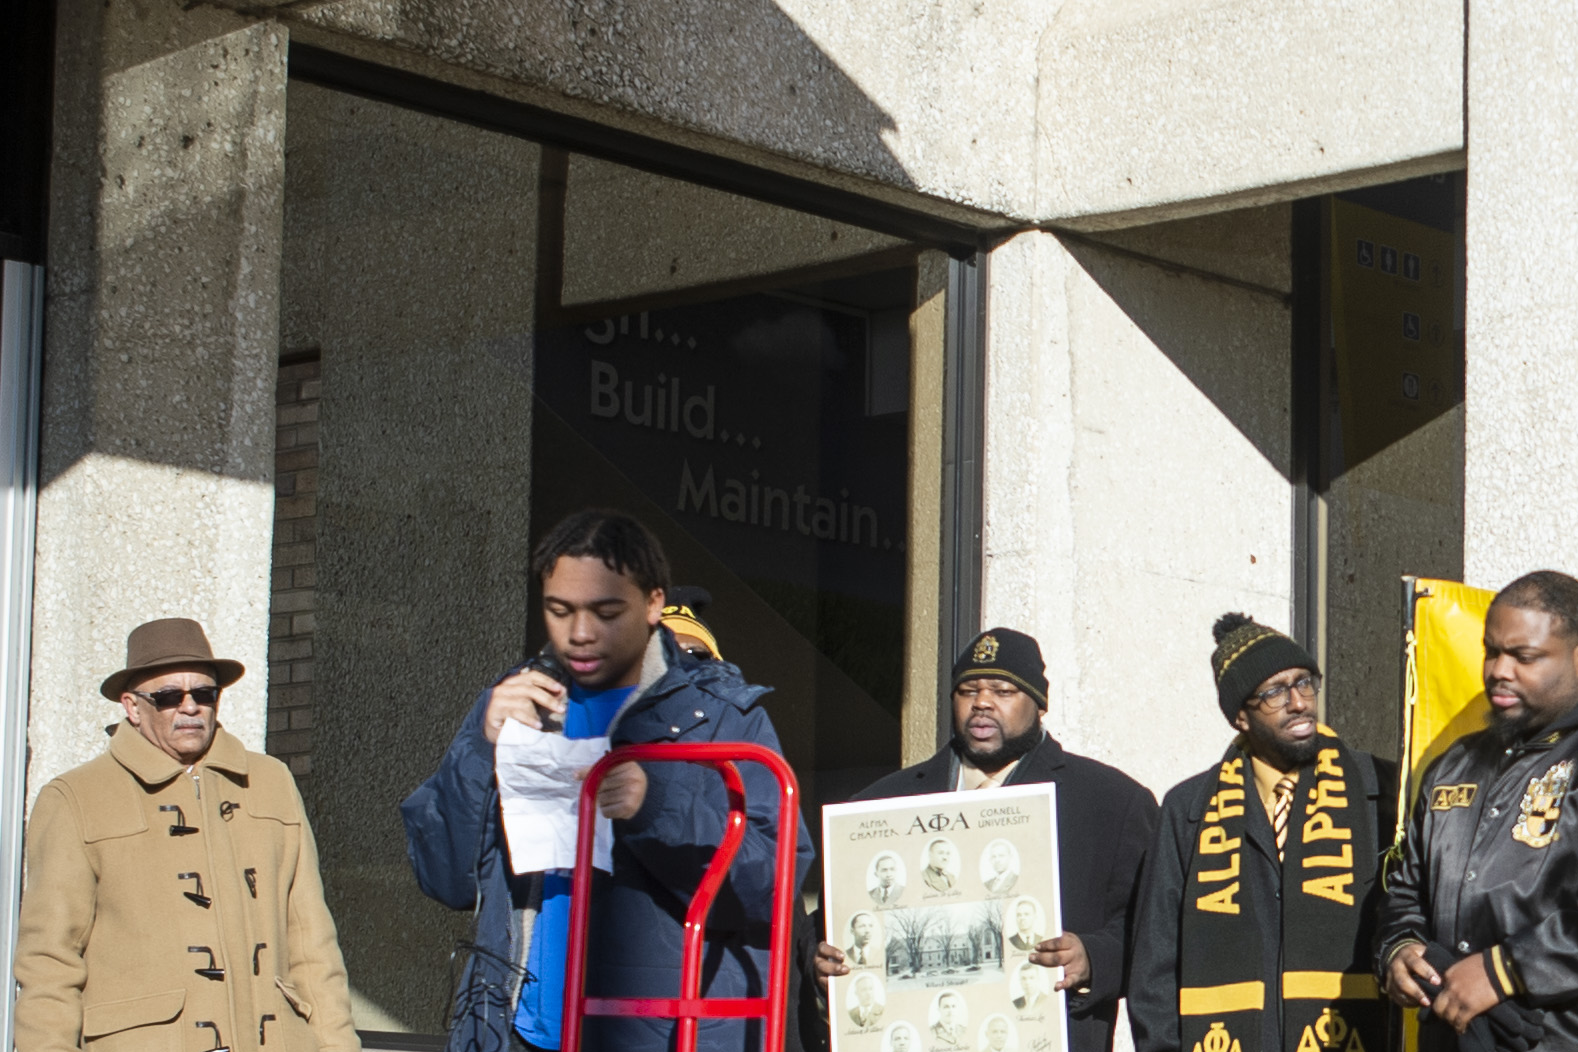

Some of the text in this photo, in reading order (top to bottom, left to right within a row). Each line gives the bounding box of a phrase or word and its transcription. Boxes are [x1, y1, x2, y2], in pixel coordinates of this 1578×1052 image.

[590, 359, 762, 450] Build...
[979, 805, 1021, 818] CORNELL
[977, 814, 1031, 829] UNIVERSITY
